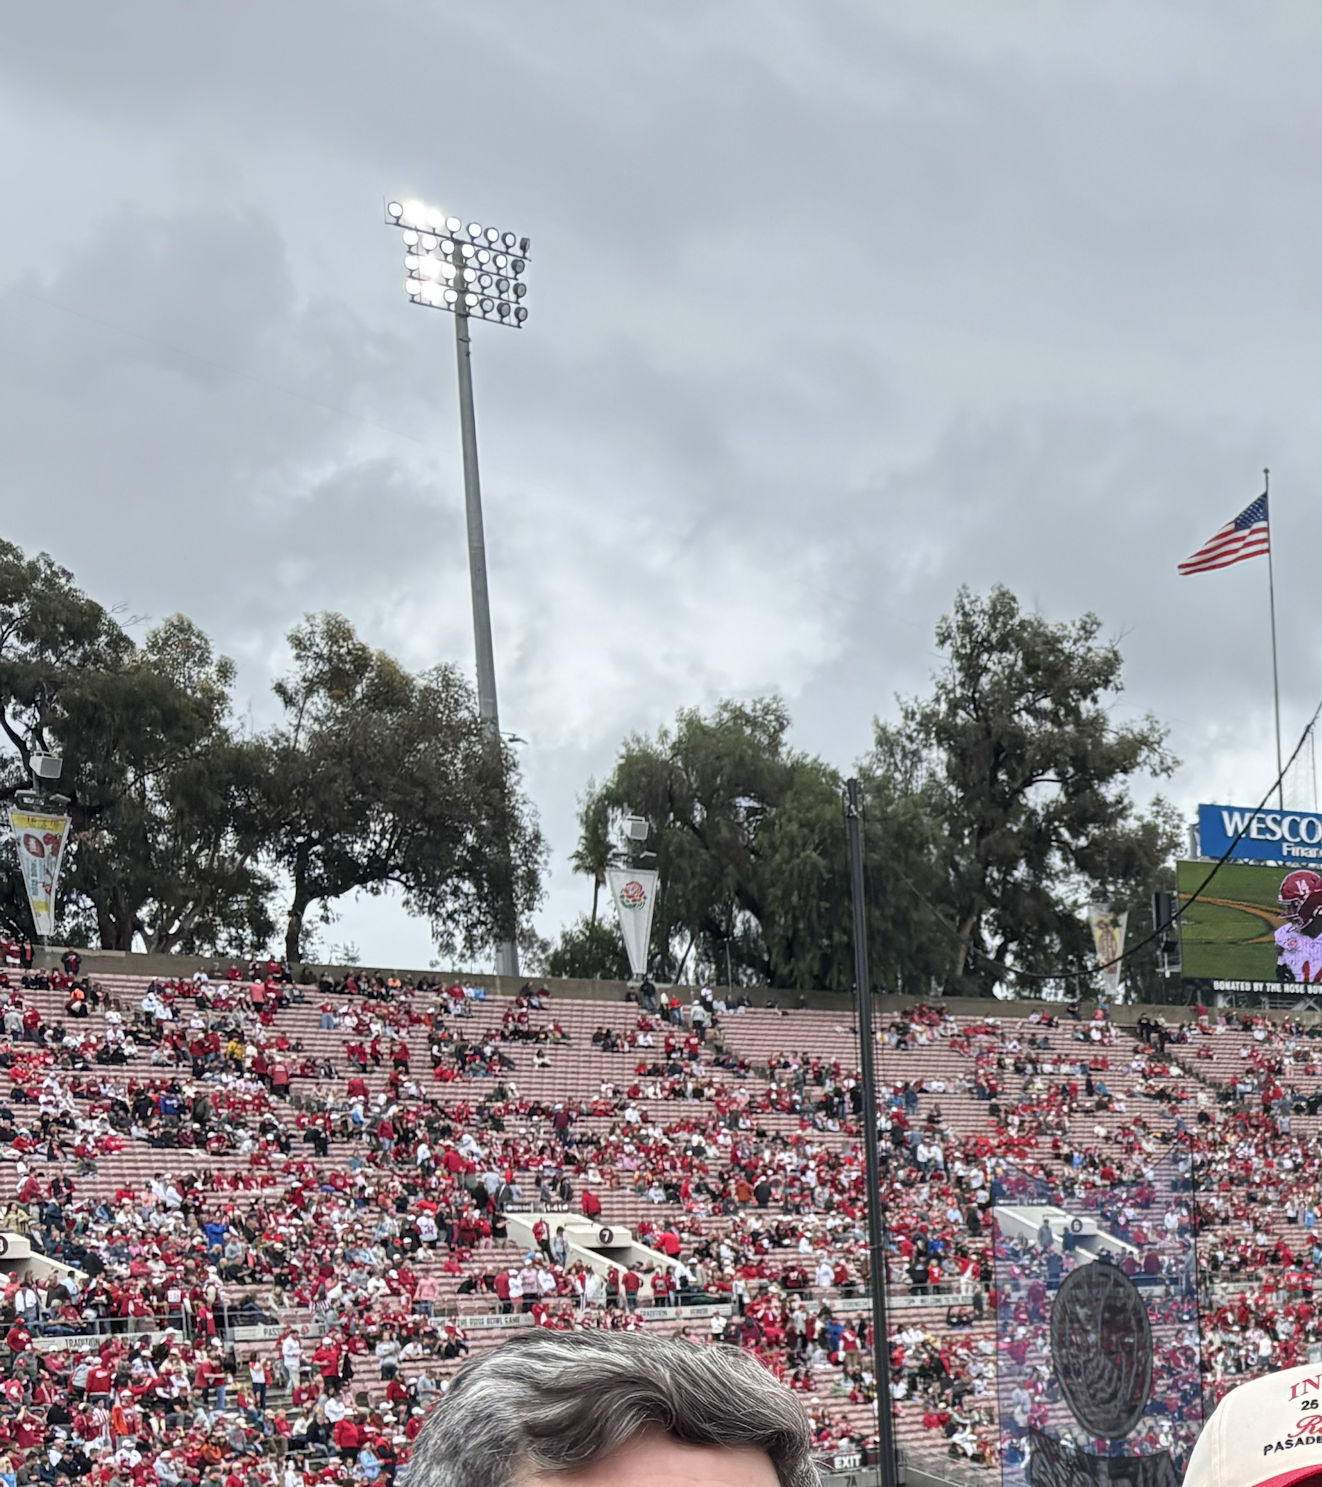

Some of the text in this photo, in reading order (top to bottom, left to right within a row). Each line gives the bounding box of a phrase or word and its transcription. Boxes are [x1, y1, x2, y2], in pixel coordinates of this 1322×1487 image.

[1253, 982, 1264, 991] BY
[1266, 983, 1282, 993] THE
[65, 1337, 100, 1349] TRADITION
[1301, 1399, 1319, 1411] 25
